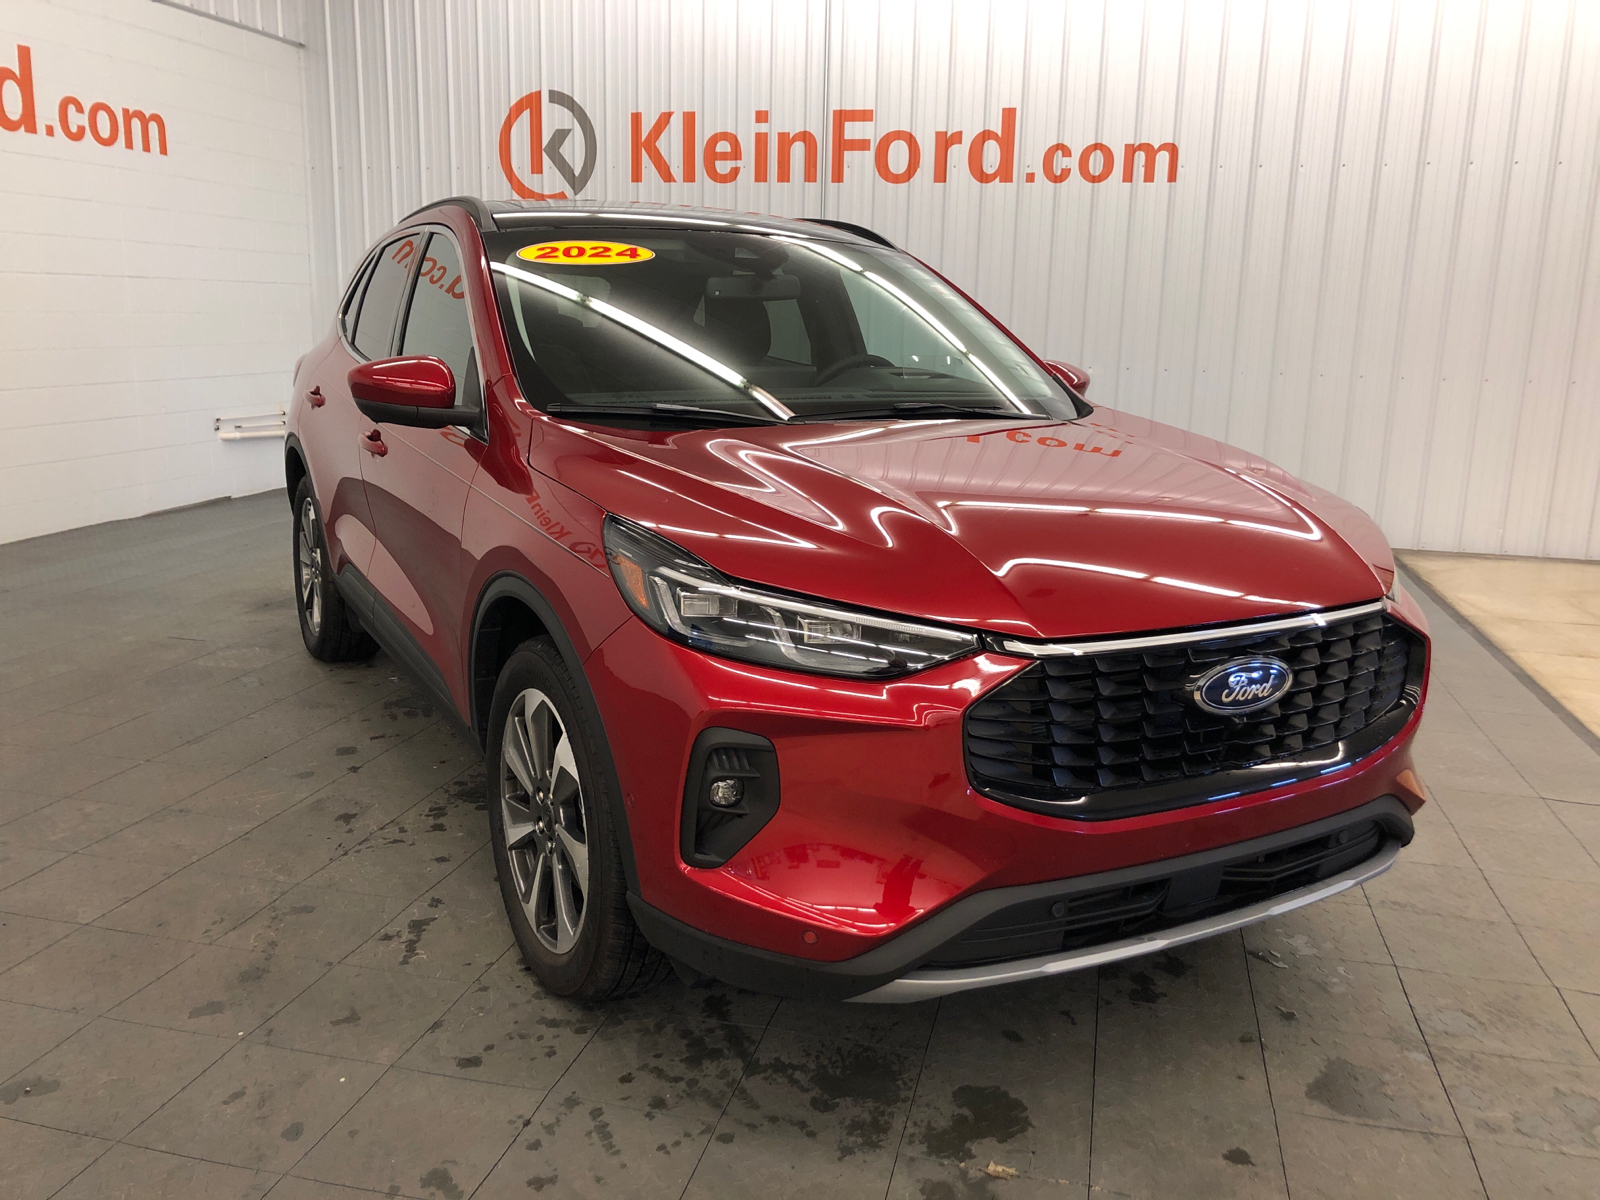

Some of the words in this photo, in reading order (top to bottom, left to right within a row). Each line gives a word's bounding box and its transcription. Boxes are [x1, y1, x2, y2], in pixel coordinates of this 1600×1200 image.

[630, 107, 1179, 185] KleinFord.com
[534, 246, 641, 259] 2024
[1221, 669, 1277, 703] Ford
